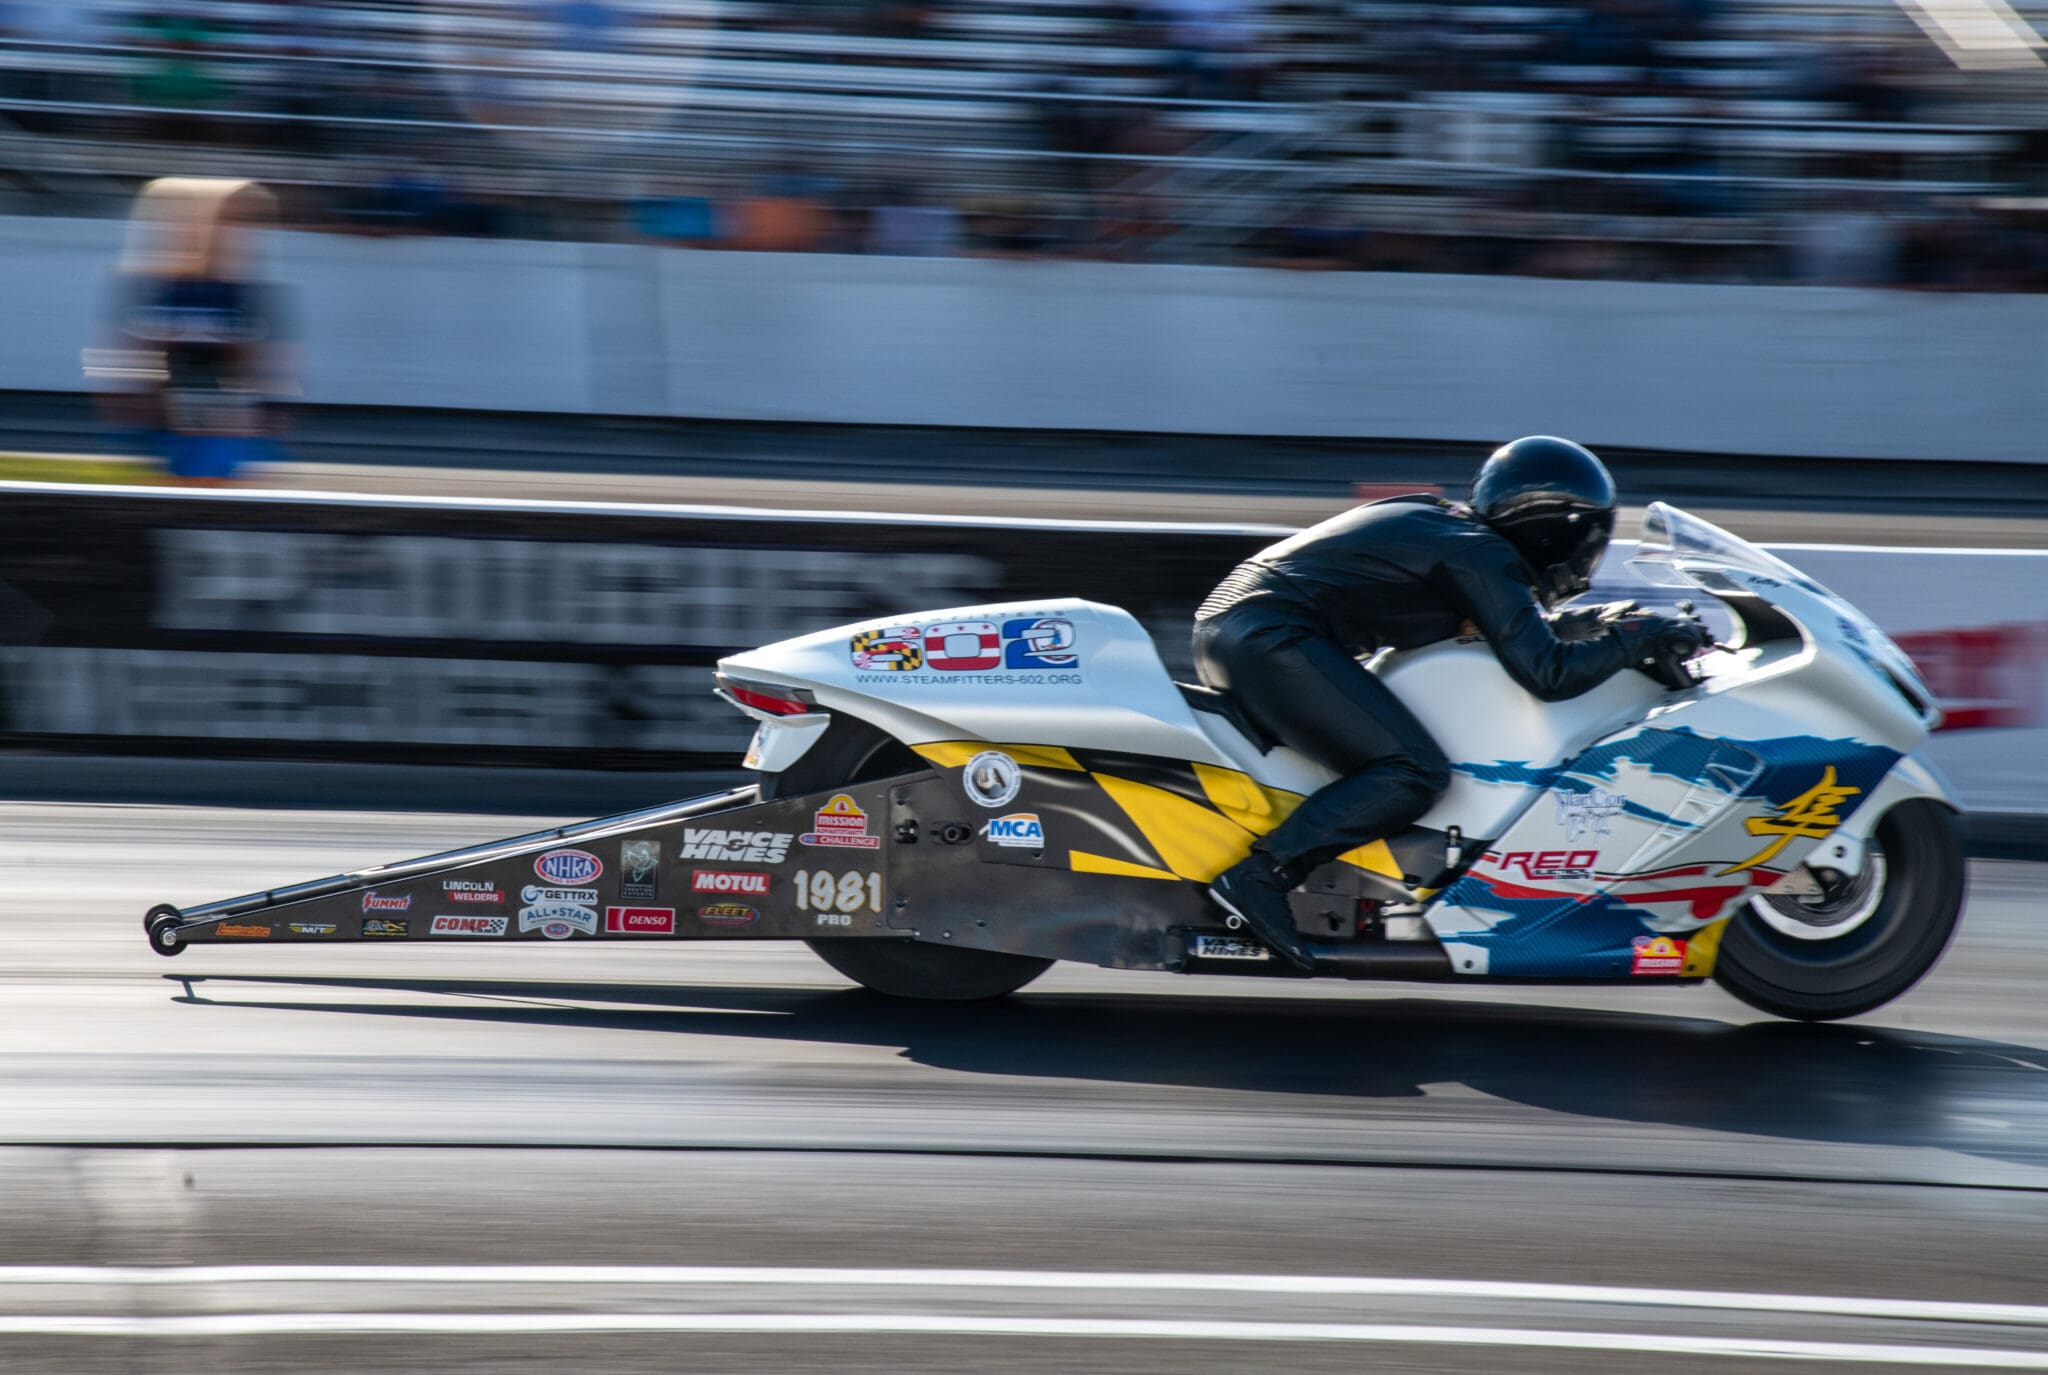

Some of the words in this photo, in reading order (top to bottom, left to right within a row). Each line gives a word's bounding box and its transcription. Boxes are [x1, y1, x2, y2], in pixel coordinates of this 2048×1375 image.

[850, 617, 1079, 671] 602
[855, 674, 1083, 685] WWW.STEAMFITTERS-602.ORG
[990, 820, 1041, 837] MCA
[683, 828, 795, 848] VANCE
[819, 835, 877, 847] CHALLENGE
[679, 844, 788, 864] HINES
[545, 856, 593, 878] NHRA
[1498, 849, 1600, 880] RED
[442, 880, 495, 892] LINCOLN
[694, 873, 766, 892] MOTUL
[453, 892, 499, 902] WELDERS
[544, 889, 596, 900] GETTRX
[793, 869, 882, 913] 1981
[527, 908, 551, 921] ALL
[558, 907, 592, 923] STAR
[628, 915, 668, 925] DENSO
[816, 913, 852, 926] PRO
[434, 917, 490, 931] COMP
